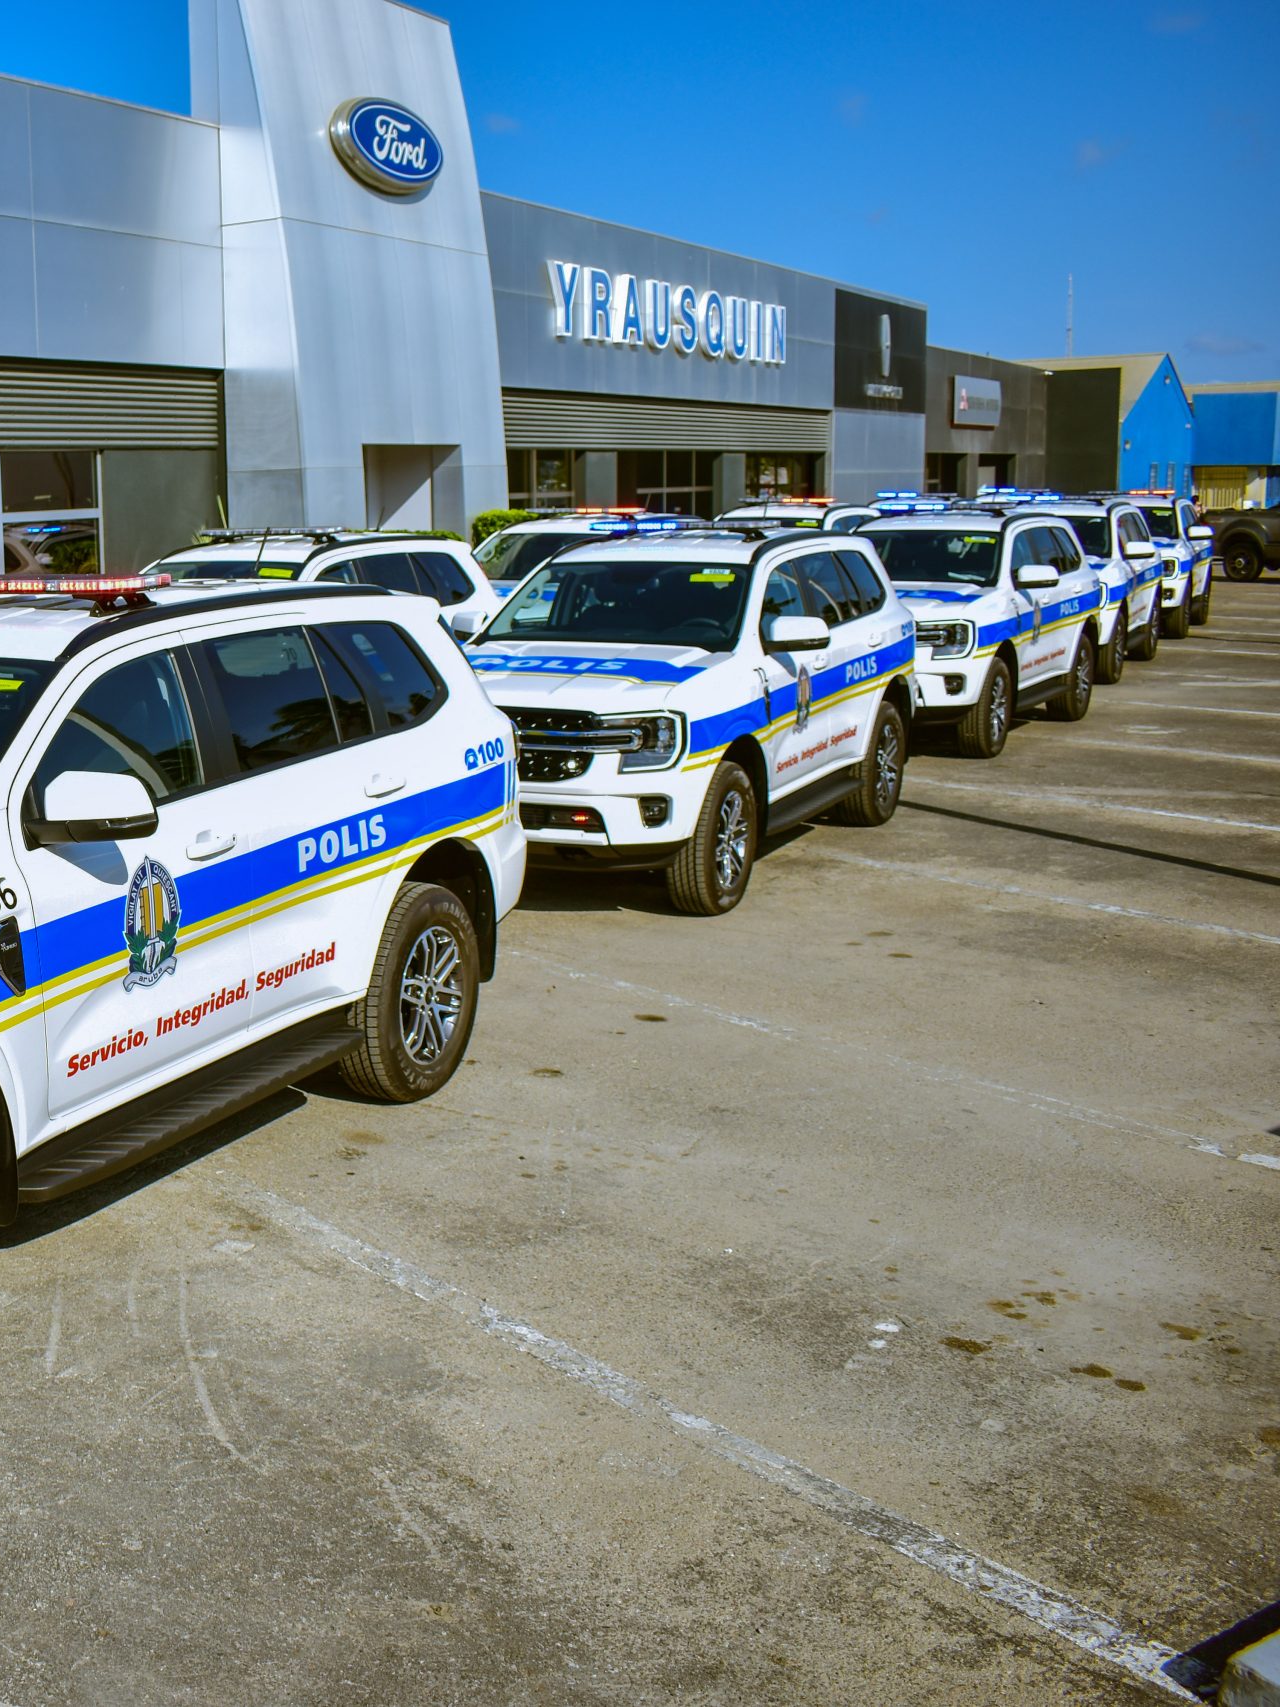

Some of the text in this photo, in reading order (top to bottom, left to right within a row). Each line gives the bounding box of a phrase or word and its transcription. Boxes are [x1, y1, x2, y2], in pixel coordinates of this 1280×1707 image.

[373, 114, 428, 170] Ford
[547, 260, 787, 364] YRAUSQUIN
[471, 658, 627, 670] POLIS
[845, 656, 877, 683] POLIS
[478, 737, 504, 764] 100
[298, 814, 387, 873] POLIS
[128, 864, 177, 926] VIGILAT UT QUIESCANT
[139, 967, 163, 983] aruba
[66, 942, 337, 1078] Servicio, Integridad, Seguridad
